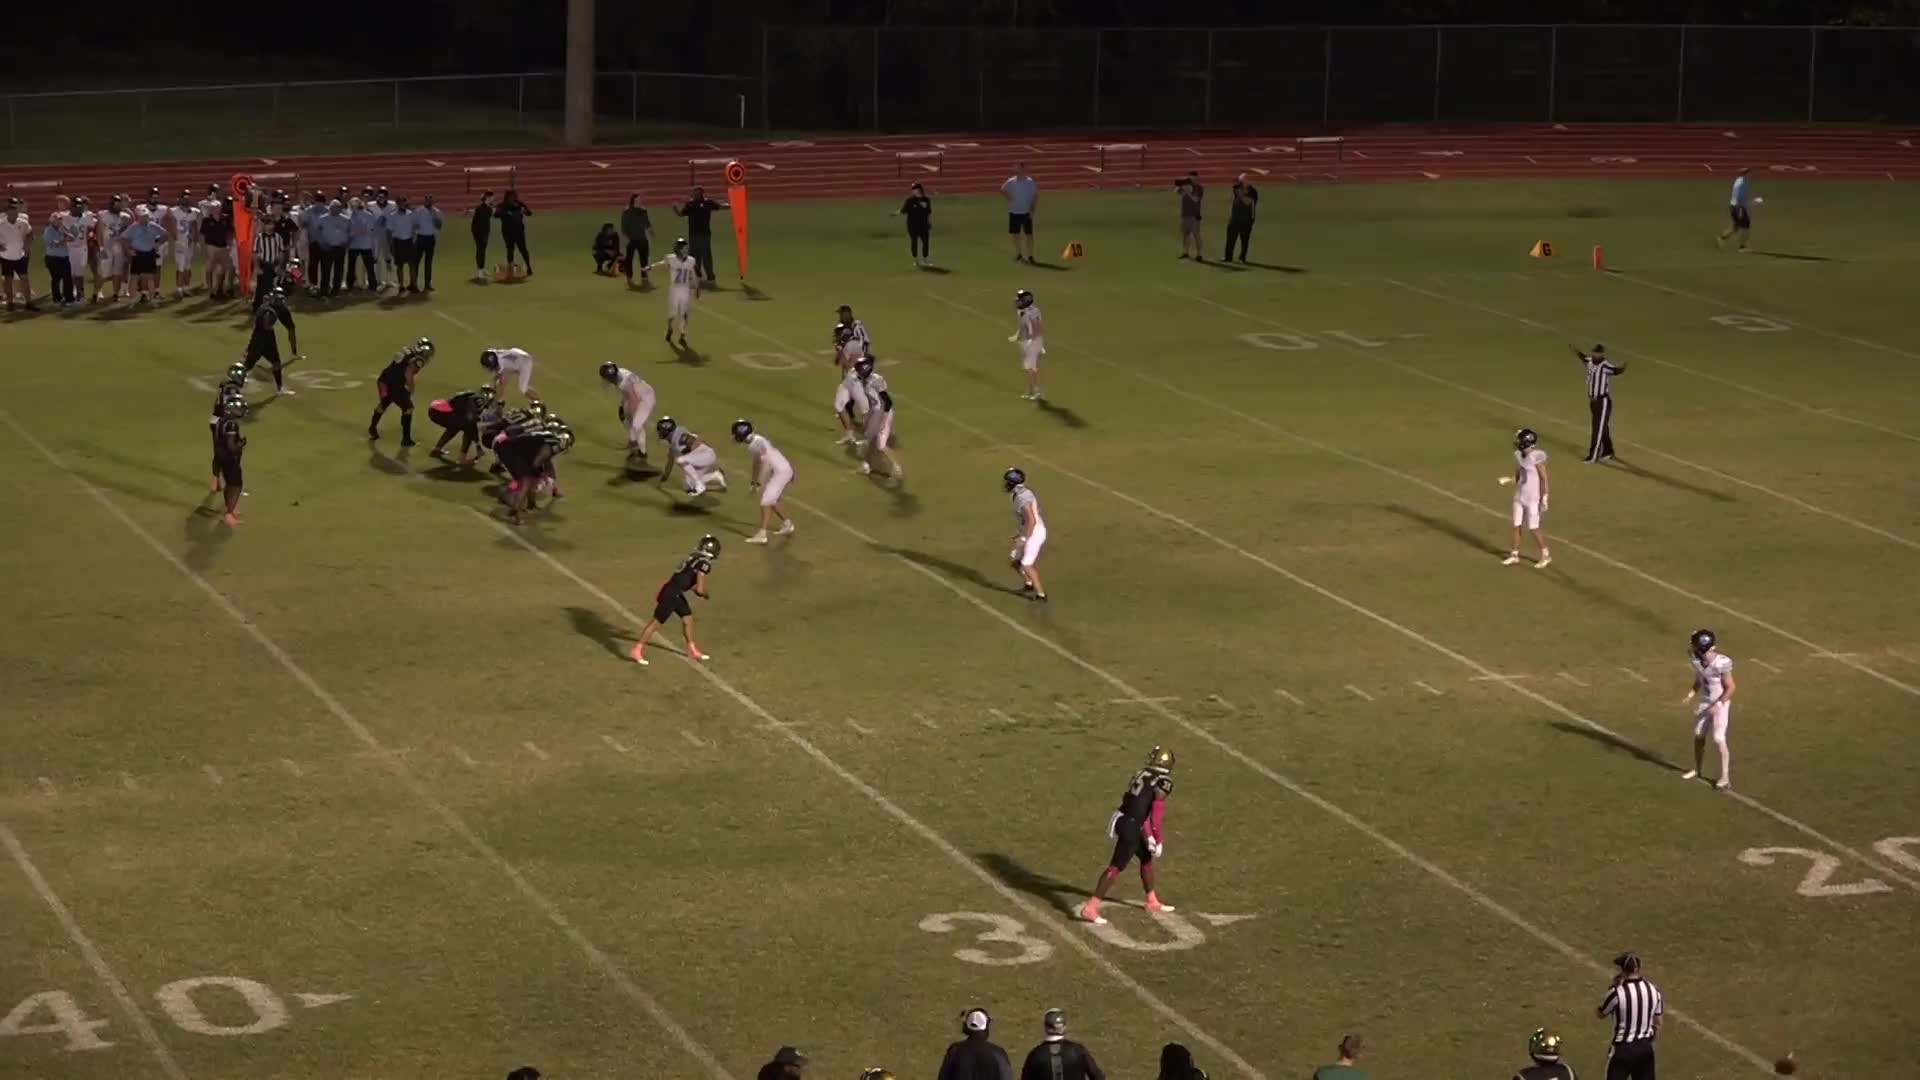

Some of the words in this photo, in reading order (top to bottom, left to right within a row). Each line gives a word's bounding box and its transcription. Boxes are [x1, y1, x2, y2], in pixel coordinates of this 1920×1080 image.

[1542, 242, 1552, 257] G
[918, 900, 1206, 966] 30
[0, 975, 291, 1050] 40
